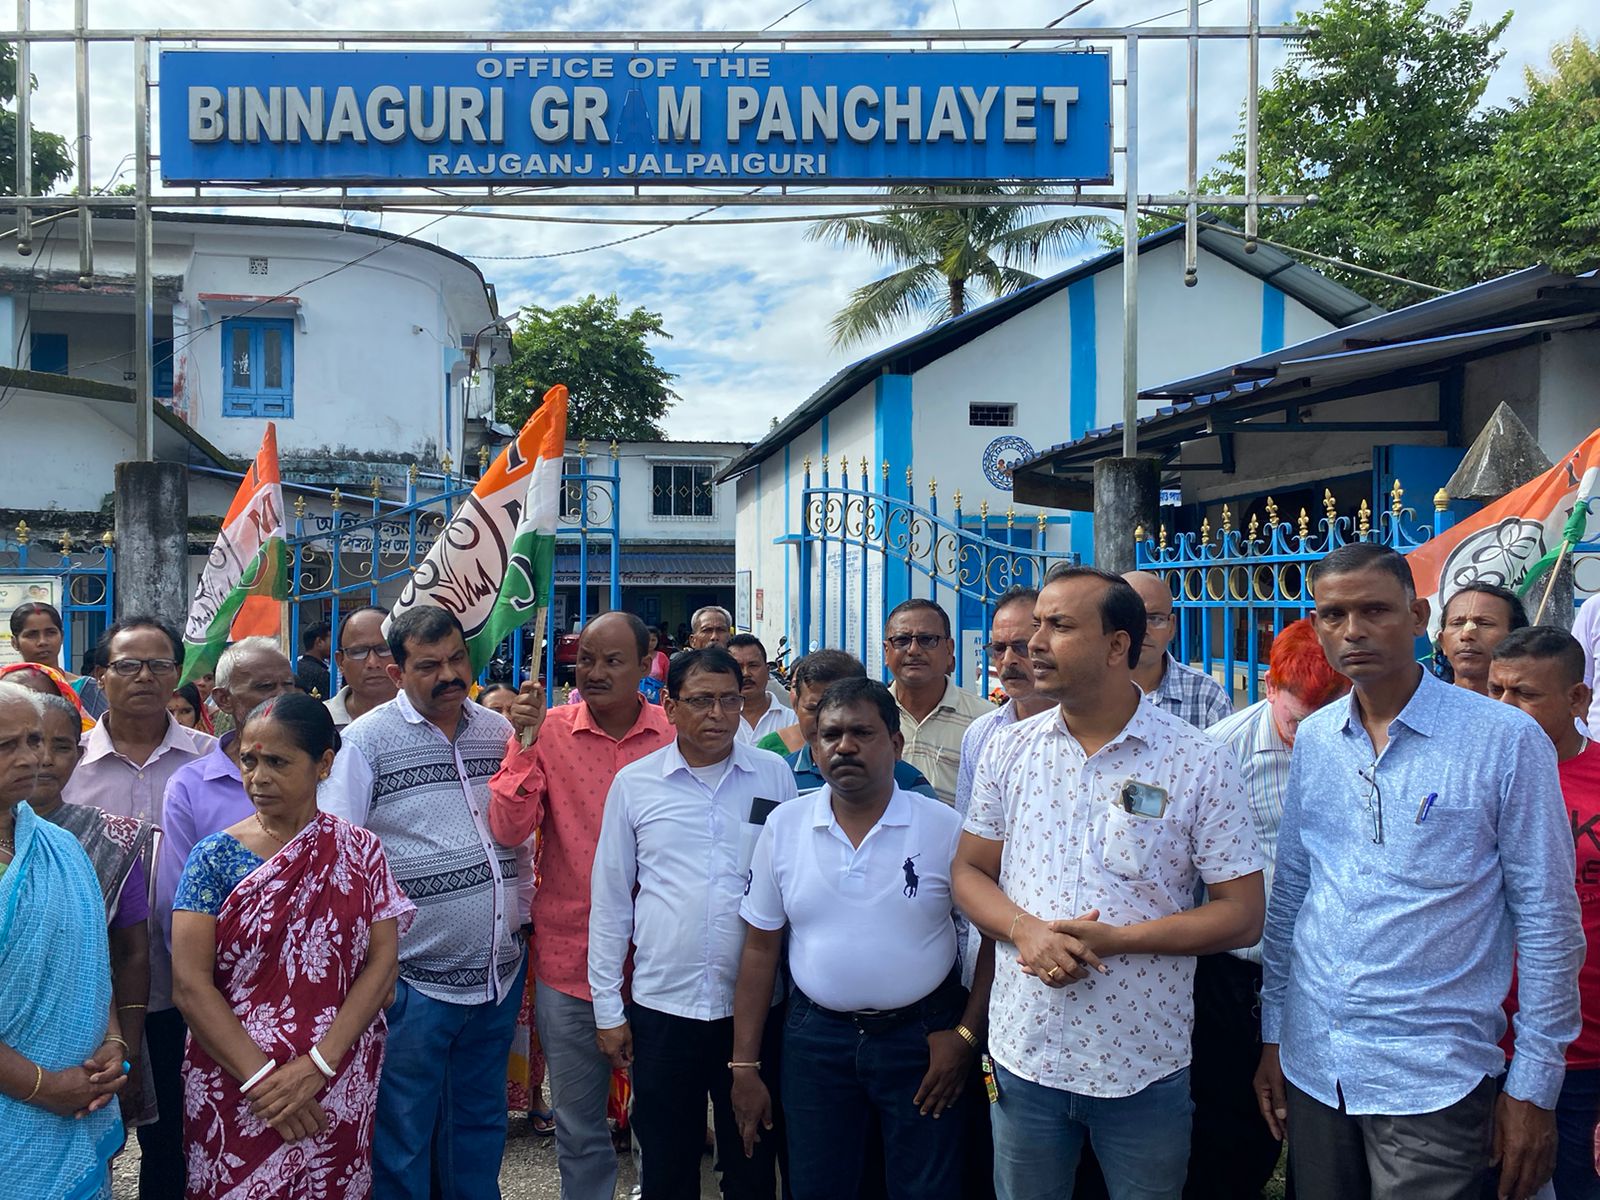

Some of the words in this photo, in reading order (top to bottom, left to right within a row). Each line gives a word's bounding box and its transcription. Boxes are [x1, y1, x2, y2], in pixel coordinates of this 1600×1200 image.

[476, 57, 614, 78] OFFICE
[628, 57, 677, 78] OF
[692, 57, 771, 78] THE
[188, 85, 505, 143] BINNAGURI
[727, 85, 1080, 143] PANCHAYET
[618, 153, 827, 175] JALPAIGURI
